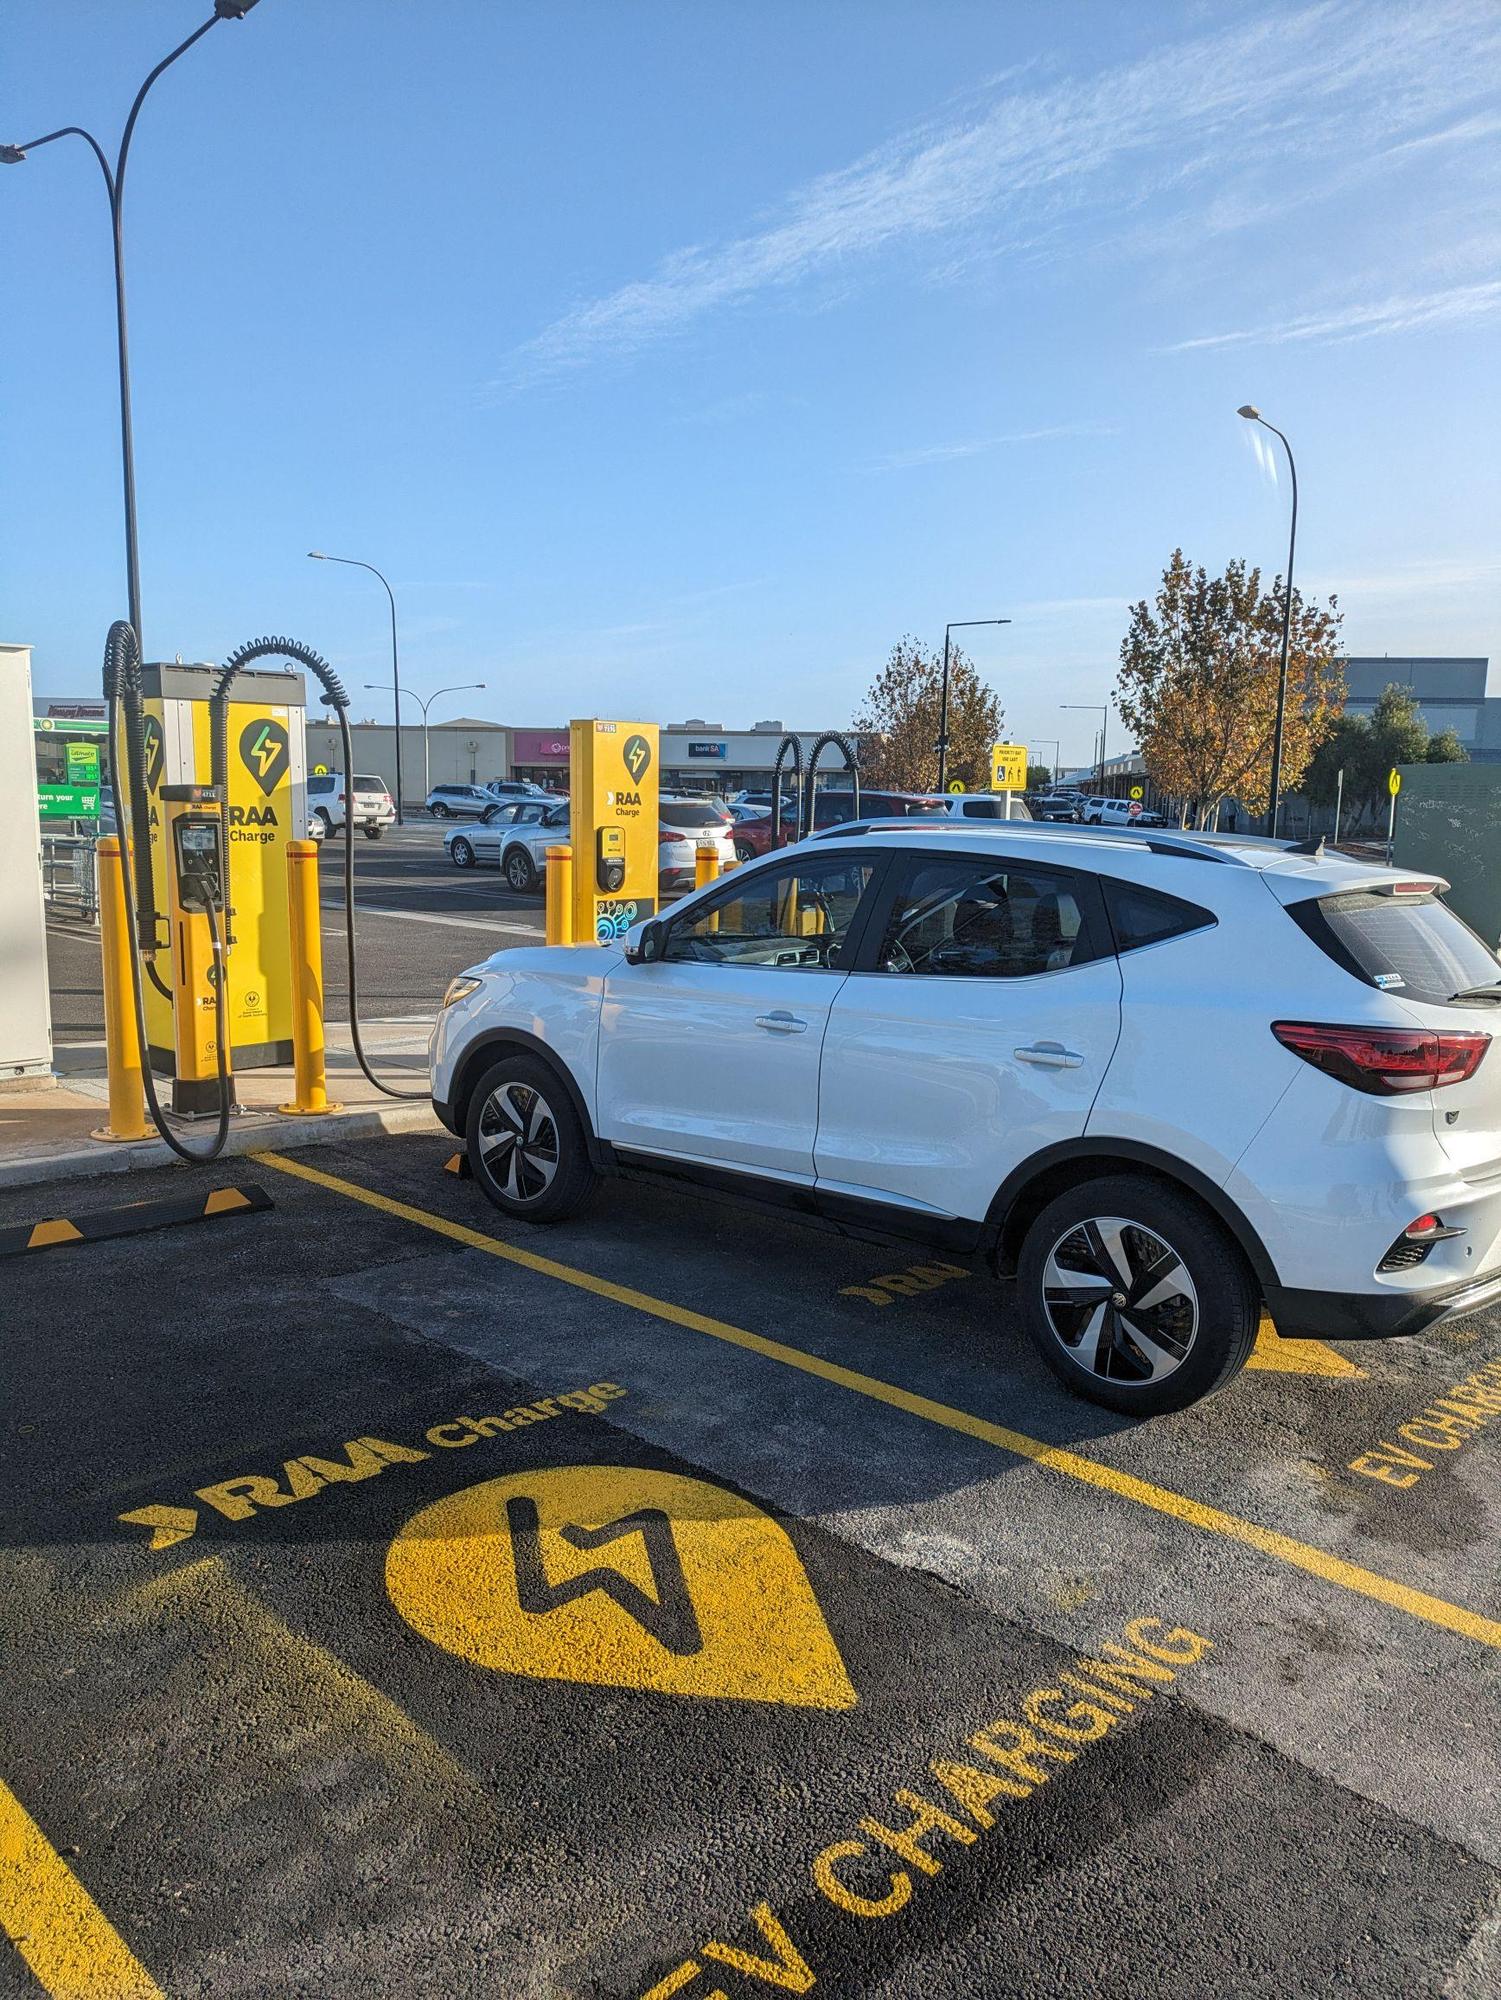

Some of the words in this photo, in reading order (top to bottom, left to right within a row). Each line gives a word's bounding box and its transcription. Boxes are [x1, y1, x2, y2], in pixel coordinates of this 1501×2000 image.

[55, 794, 74, 803] your
[616, 792, 642, 806] RAA
[228, 806, 278, 826] RAA
[616, 807, 640, 817] Charge
[230, 830, 275, 844] Charge
[1347, 1441, 1434, 1489] EV
[1398, 1357, 1501, 1450] CHARG
[194, 1436, 431, 1521] RAA
[811, 1615, 1214, 1918] CHARGING
